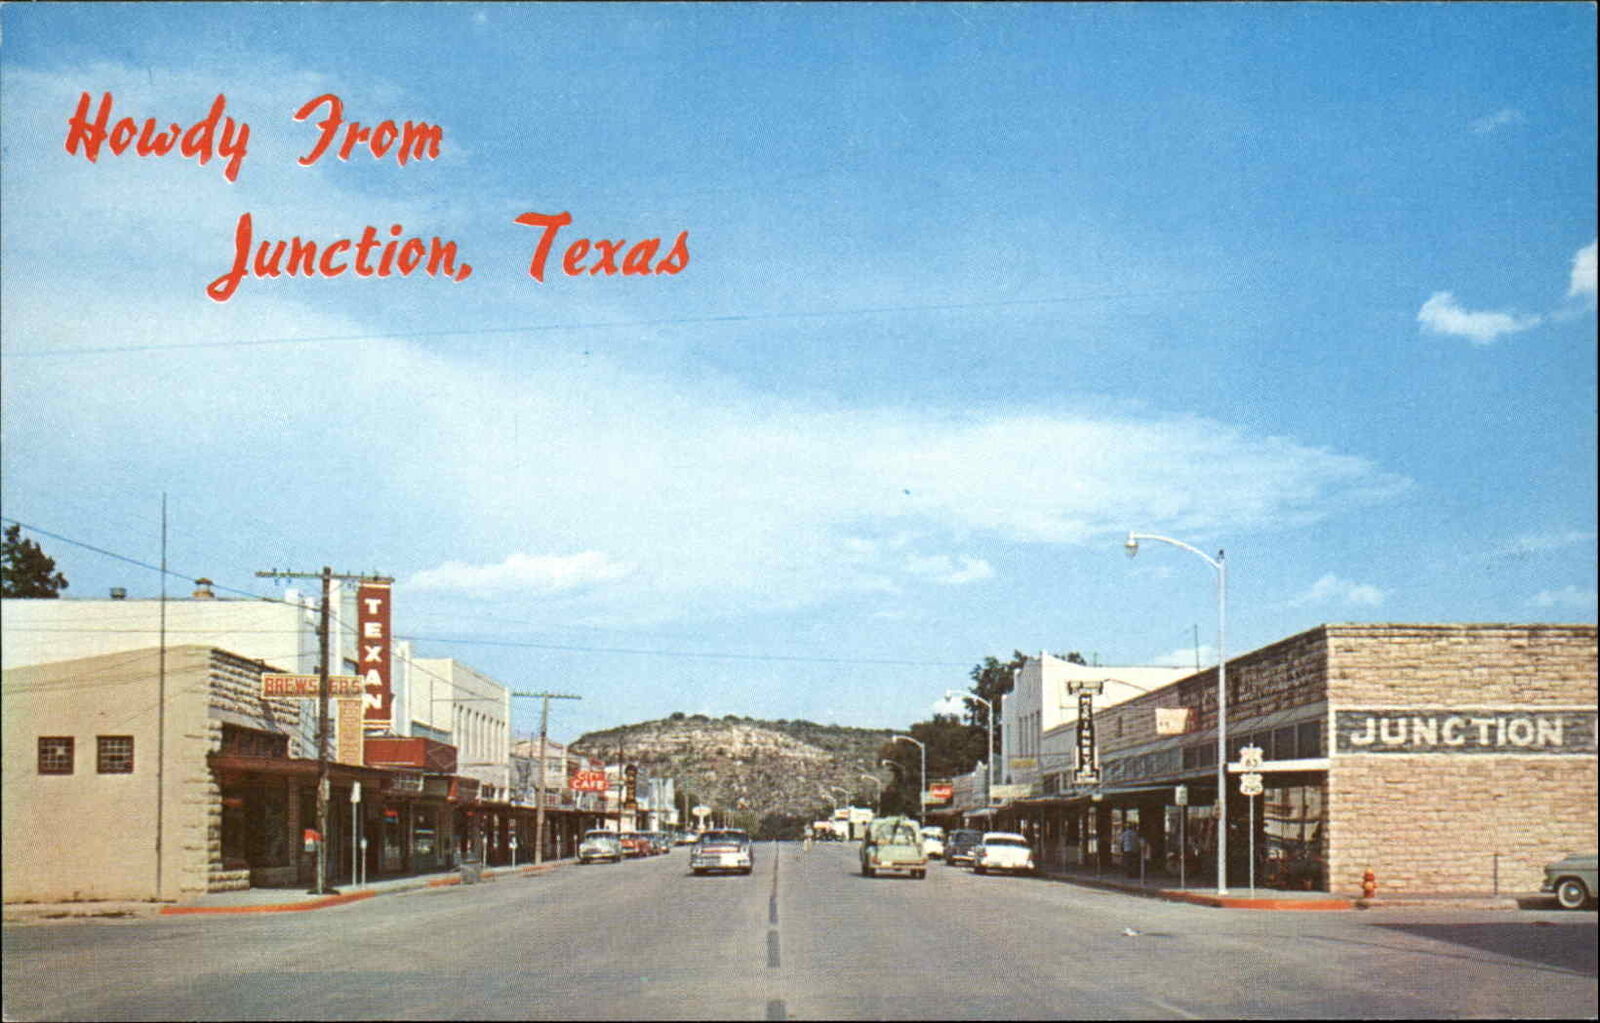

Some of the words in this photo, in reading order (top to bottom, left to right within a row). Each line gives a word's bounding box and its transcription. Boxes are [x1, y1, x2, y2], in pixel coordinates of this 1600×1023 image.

[362, 598, 383, 710] TEXAN
[264, 677, 361, 696] BREWSERS
[1350, 717, 1564, 746] JUNCTION
[572, 780, 606, 791] CAFE
